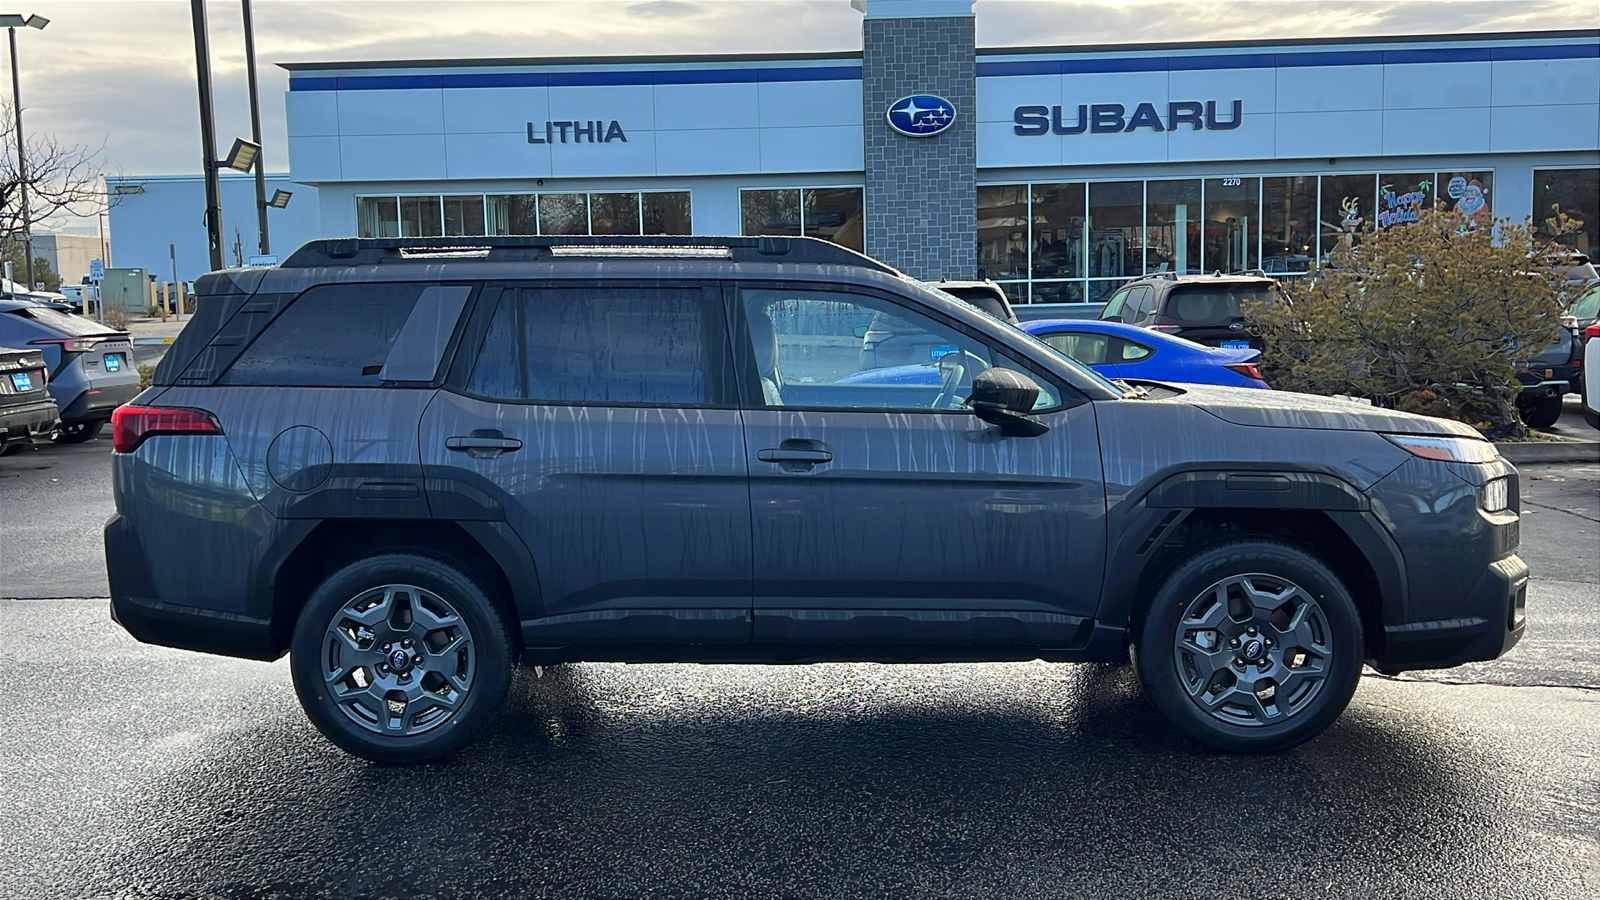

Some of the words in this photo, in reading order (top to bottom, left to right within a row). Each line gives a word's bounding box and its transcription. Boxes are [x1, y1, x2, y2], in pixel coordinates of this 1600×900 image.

[1014, 99, 1243, 136] SUBARU
[526, 120, 628, 144] LITHIA
[1222, 178, 1241, 186] 2270
[1384, 190, 1426, 209] Happy
[1379, 206, 1429, 228] Holida
